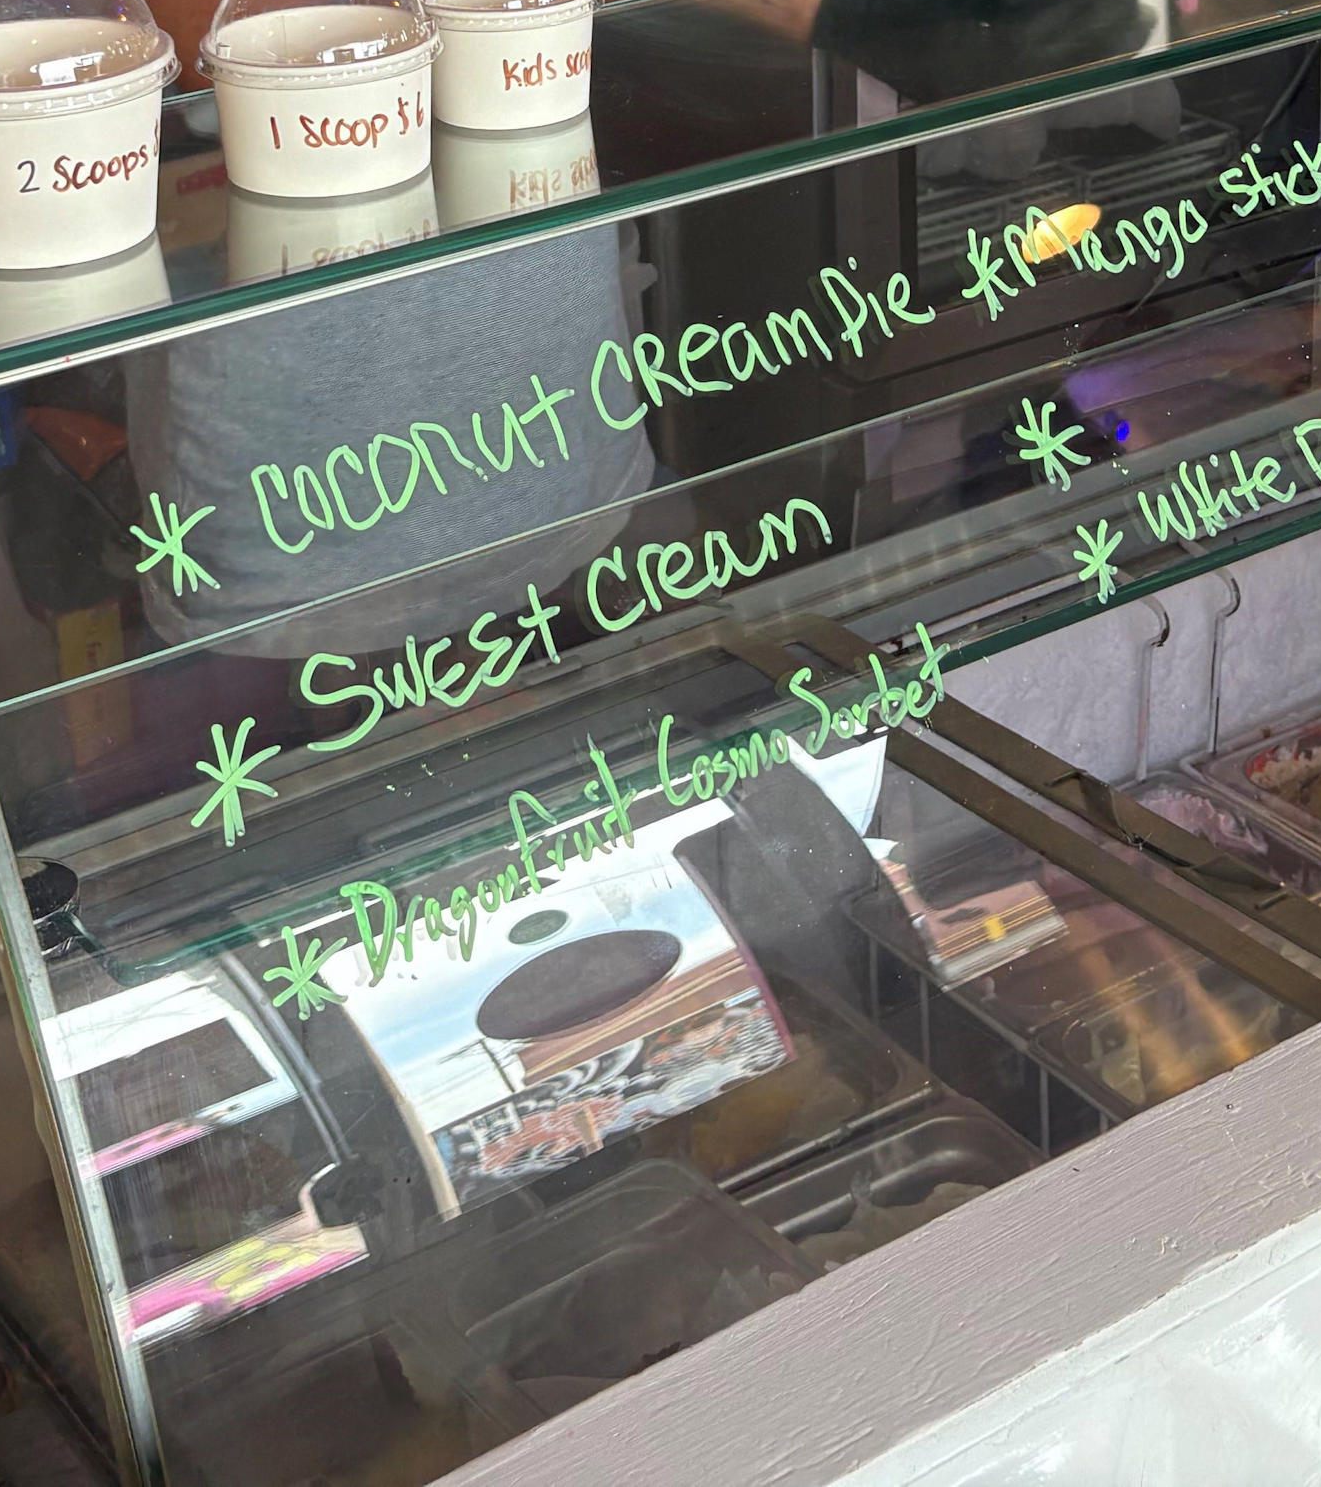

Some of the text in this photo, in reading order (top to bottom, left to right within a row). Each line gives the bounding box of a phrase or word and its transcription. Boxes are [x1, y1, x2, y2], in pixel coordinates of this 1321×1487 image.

[502, 52, 557, 91] Kids
[270, 116, 281, 149] 1
[16, 160, 40, 194] 2
[819, 255, 936, 361] Pie
[587, 498, 834, 633] Cream
